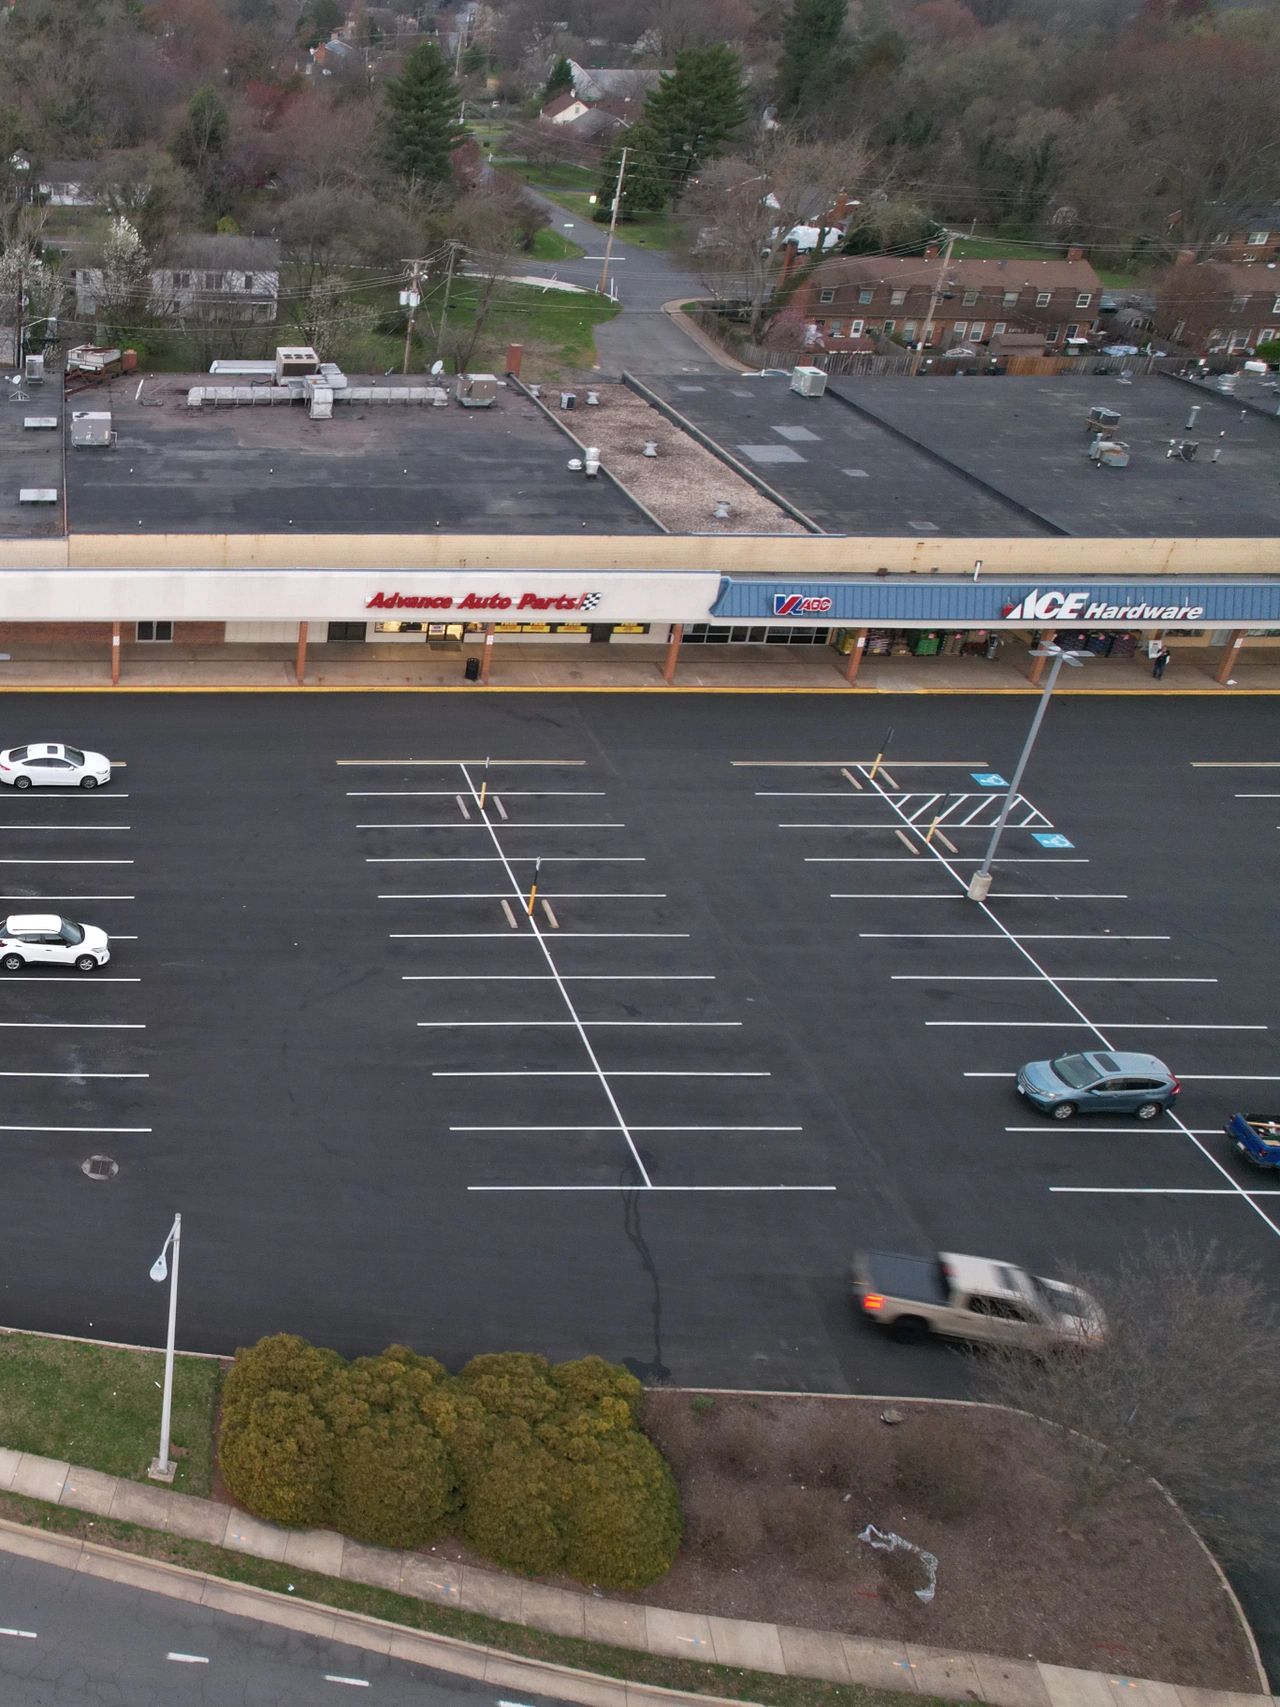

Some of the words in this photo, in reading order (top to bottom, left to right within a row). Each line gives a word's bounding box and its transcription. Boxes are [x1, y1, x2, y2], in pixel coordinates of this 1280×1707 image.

[366, 592, 453, 609] Advance
[457, 593, 513, 610] Auto
[517, 593, 577, 610] Parts
[799, 597, 832, 612] ABC
[1006, 588, 1090, 619] ACE
[1084, 603, 1204, 619] Hardware
